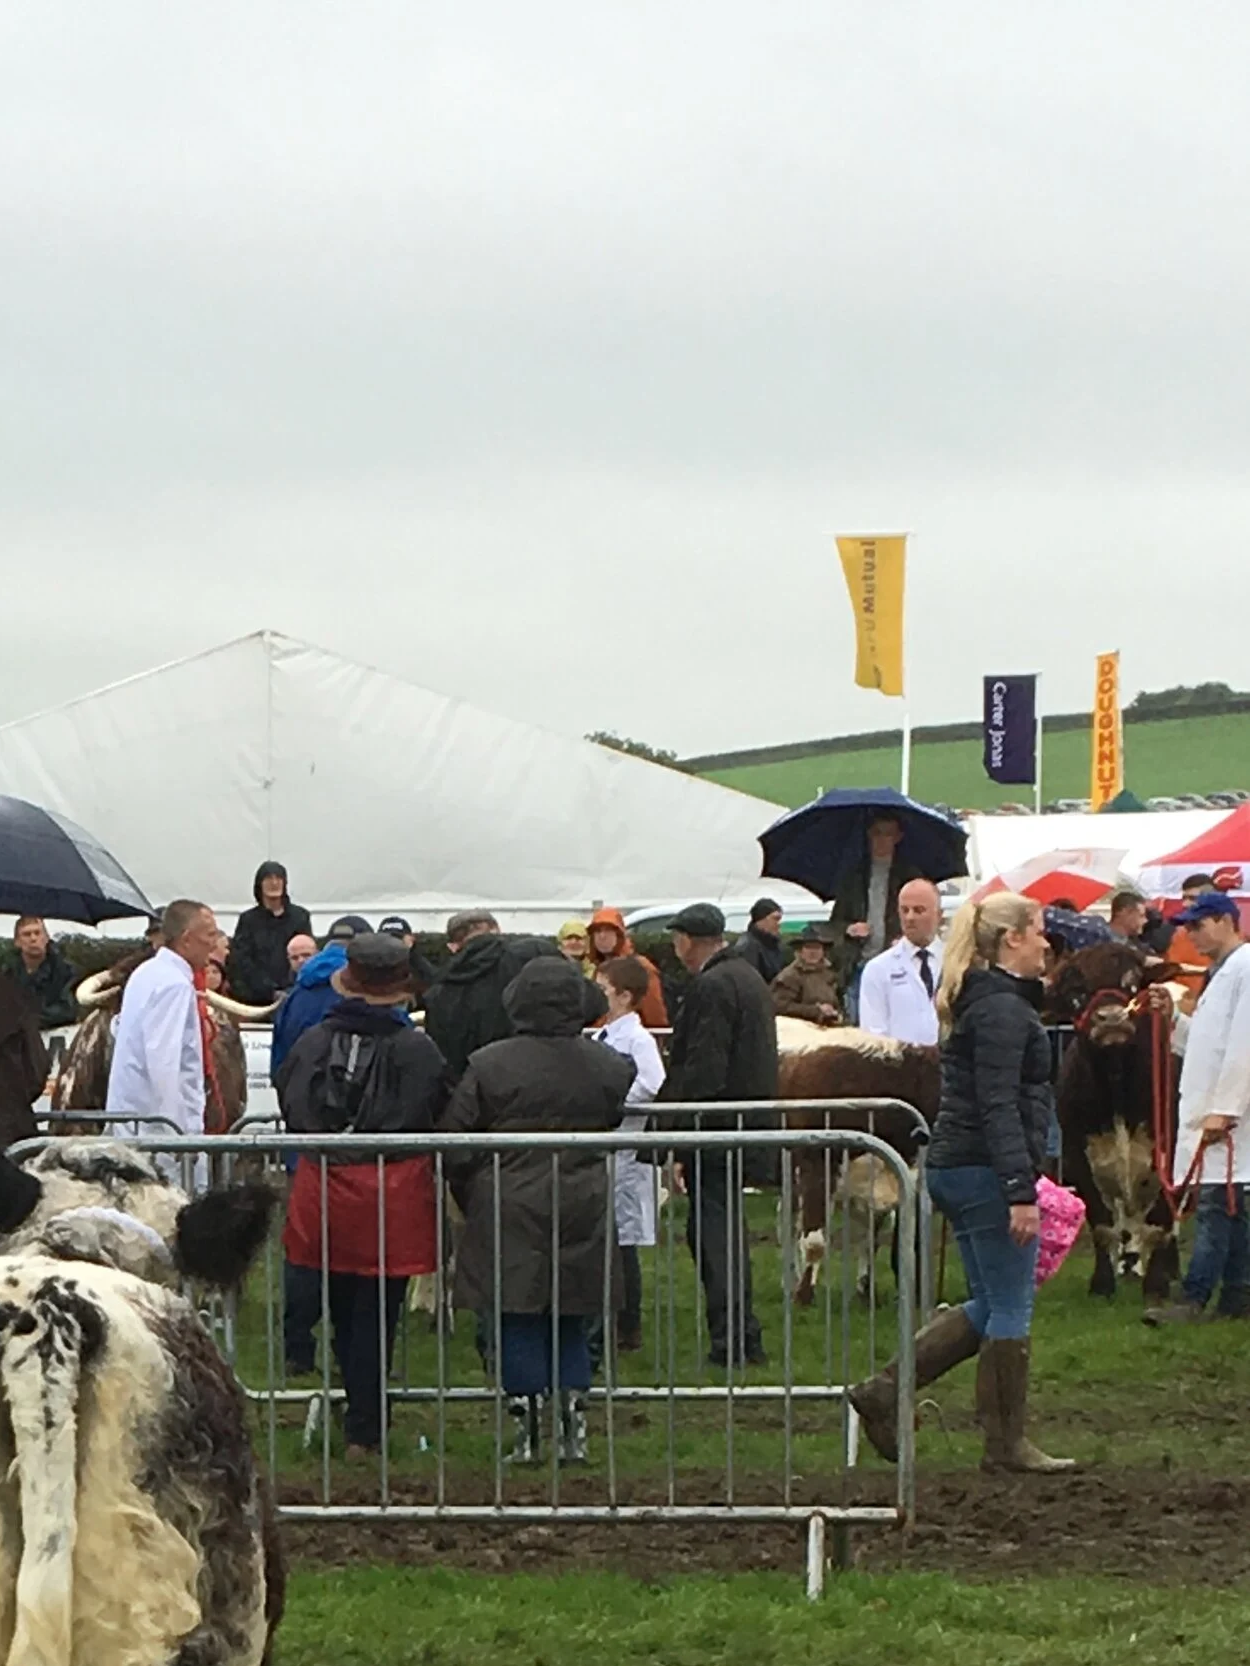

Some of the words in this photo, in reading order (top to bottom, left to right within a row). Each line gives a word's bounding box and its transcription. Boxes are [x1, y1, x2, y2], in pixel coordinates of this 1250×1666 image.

[860, 540, 876, 614] Mutual
[992, 681, 1007, 727] Carter
[1098, 660, 1116, 800] DOUGHNUT
[988, 728, 1006, 768] Jonas
